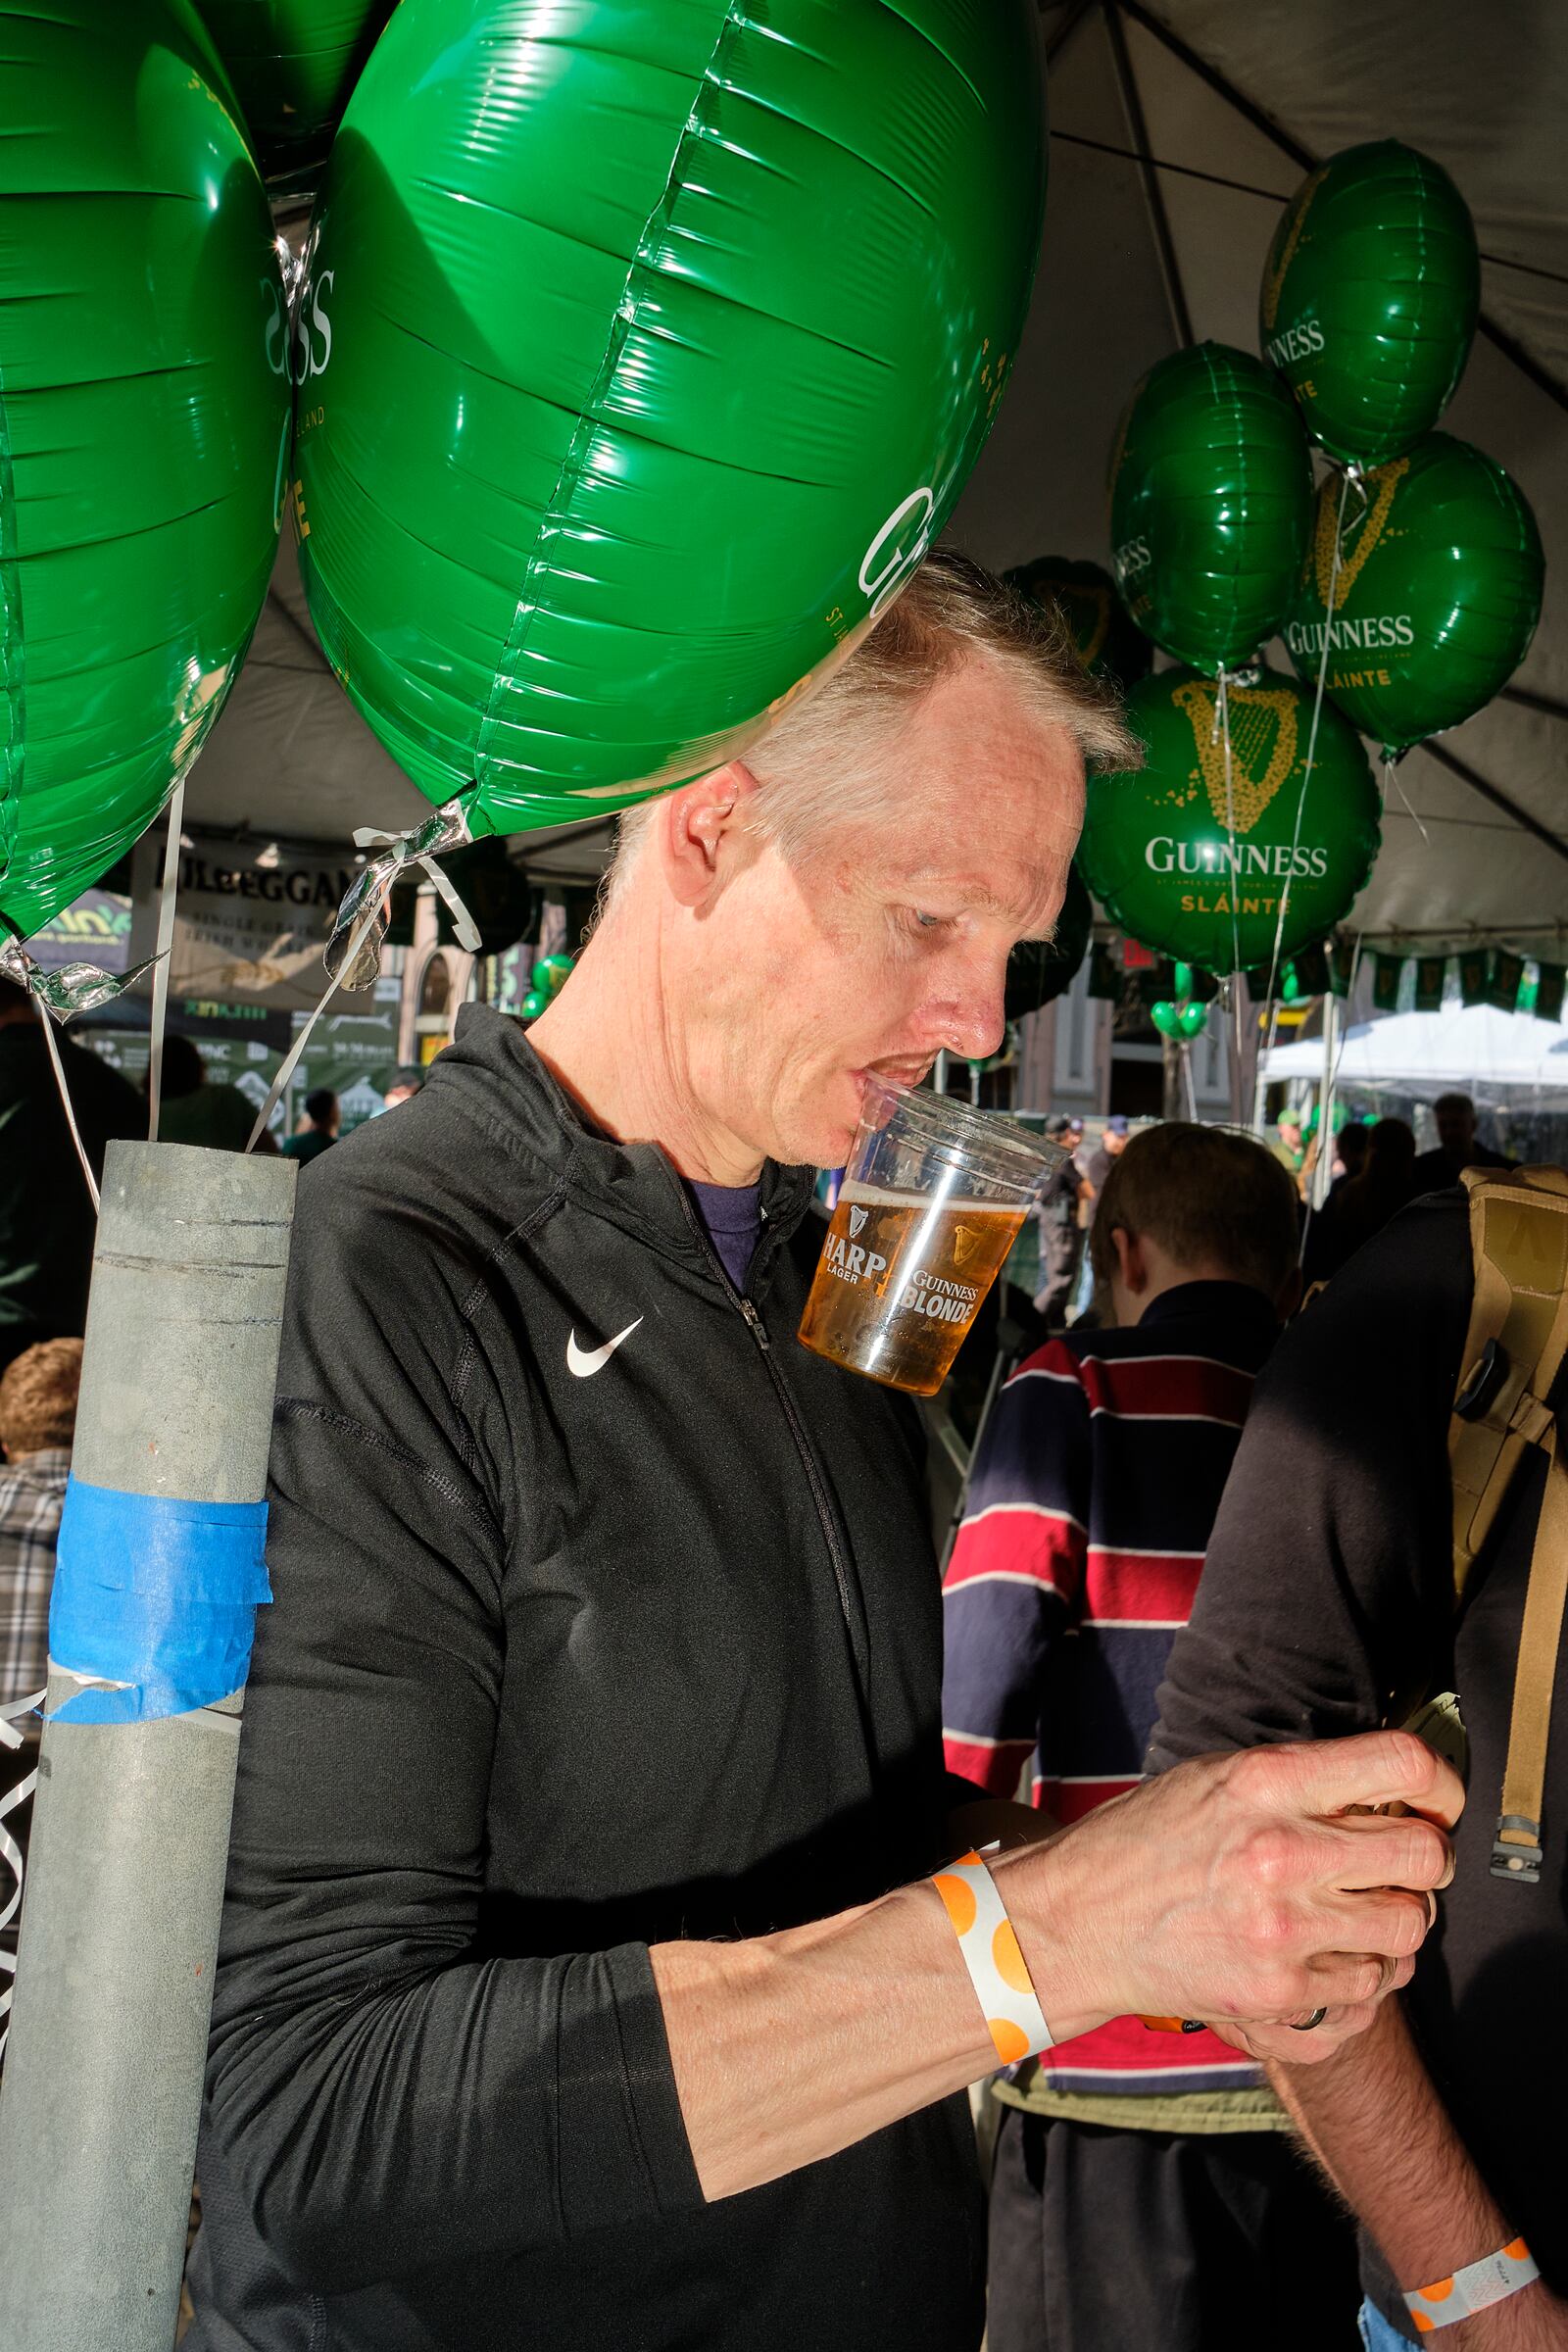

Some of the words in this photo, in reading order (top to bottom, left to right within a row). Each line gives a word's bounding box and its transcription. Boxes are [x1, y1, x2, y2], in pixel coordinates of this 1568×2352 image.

[1288, 615, 1414, 655] GUINNESS
[1145, 836, 1328, 877] GUINNESS
[823, 1232, 887, 1280] HARP
[826, 1262, 858, 1285] LAGER
[900, 1285, 974, 1324] BLONDE
[912, 1269, 979, 1301] GUINNESS
